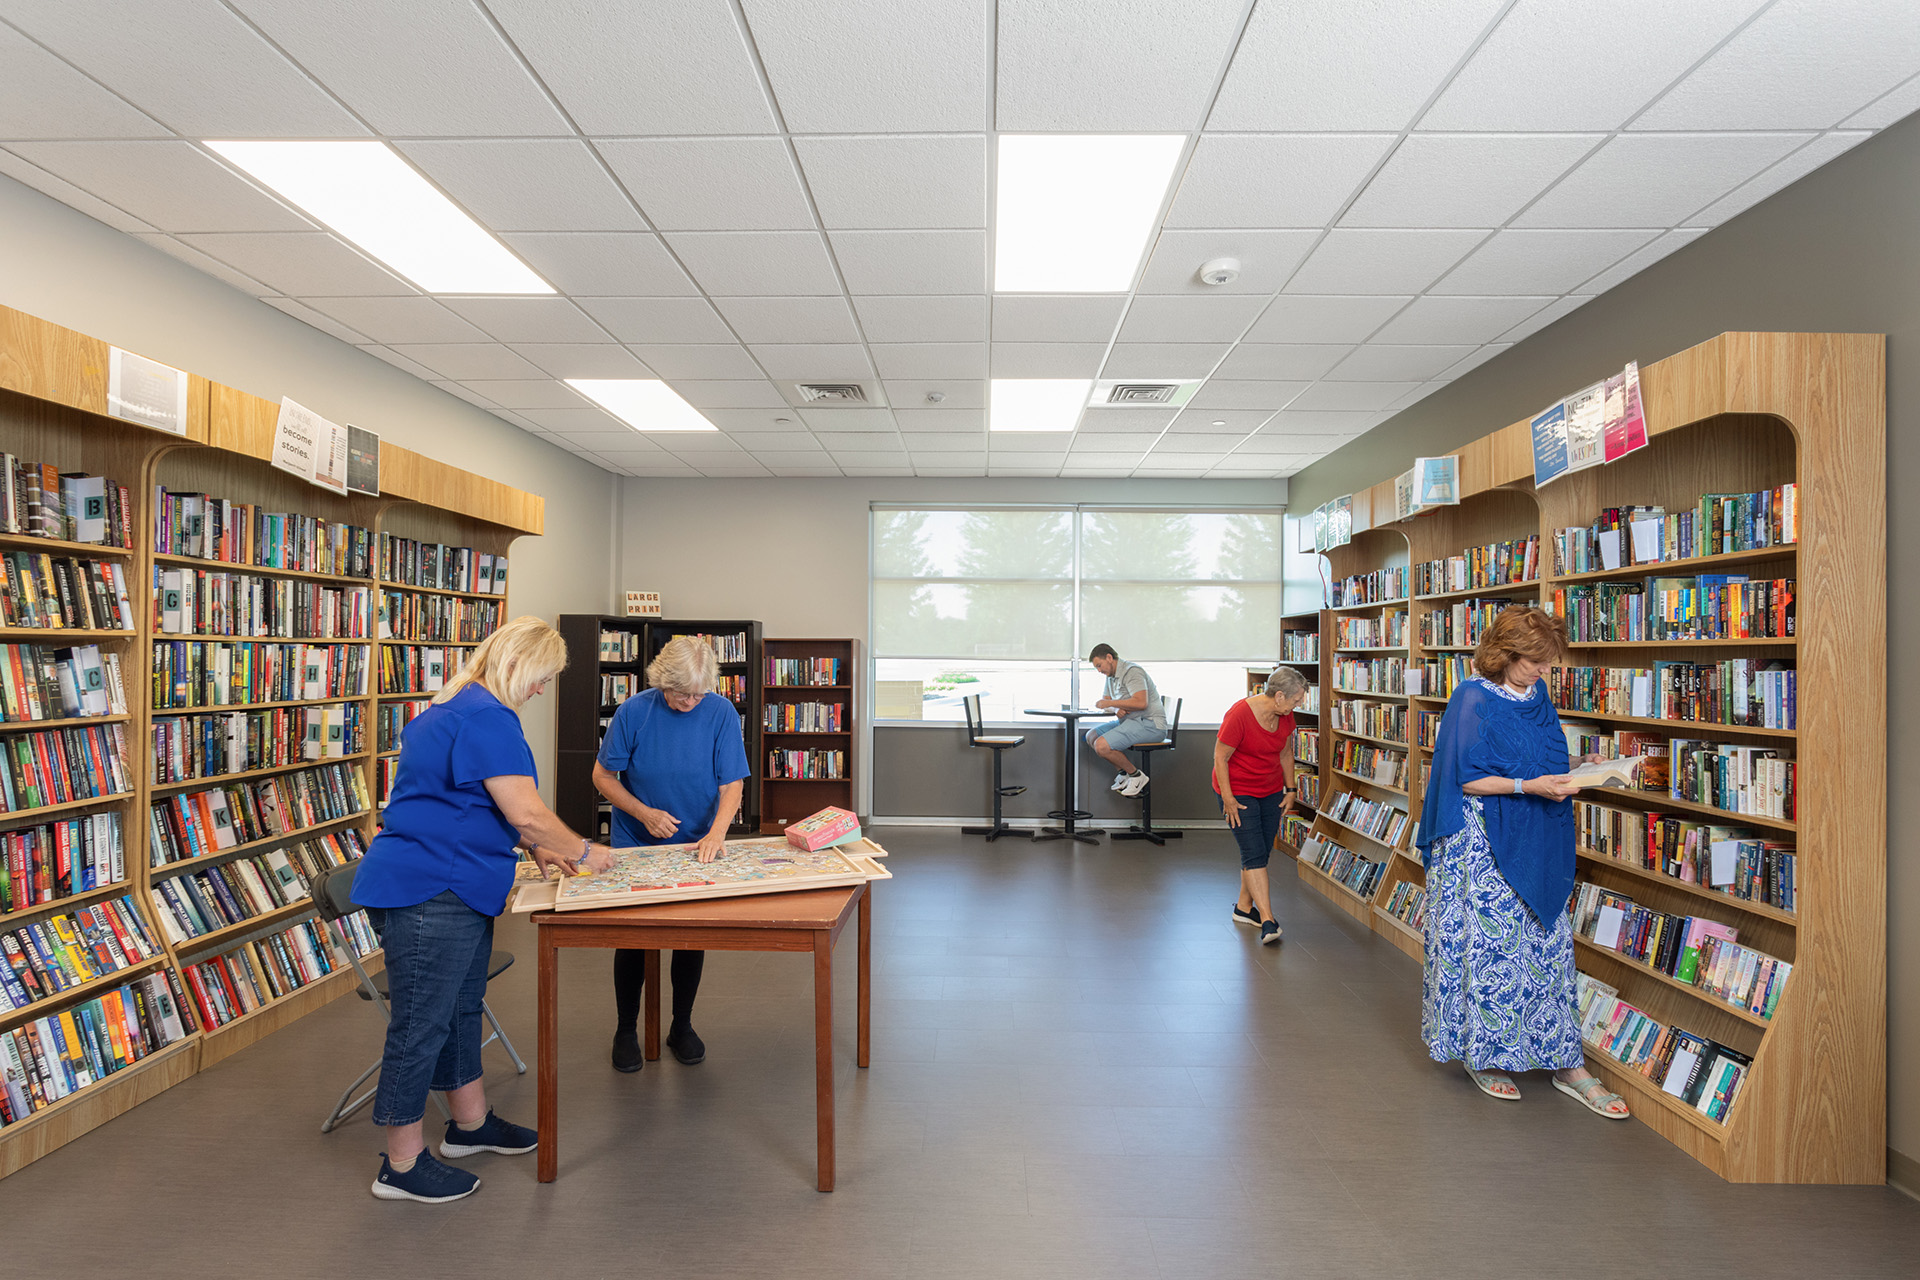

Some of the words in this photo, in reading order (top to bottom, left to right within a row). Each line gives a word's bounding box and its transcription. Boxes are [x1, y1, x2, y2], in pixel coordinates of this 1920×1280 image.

[282, 424, 312, 446] become
[282, 441, 310, 460] stories.
[88, 500, 100, 515] B
[481, 568, 488, 578] N
[168, 593, 177, 608] G
[88, 671, 98, 686] C
[308, 668, 317, 680] H
[332, 727, 340, 739] J
[215, 811, 227, 825] K
